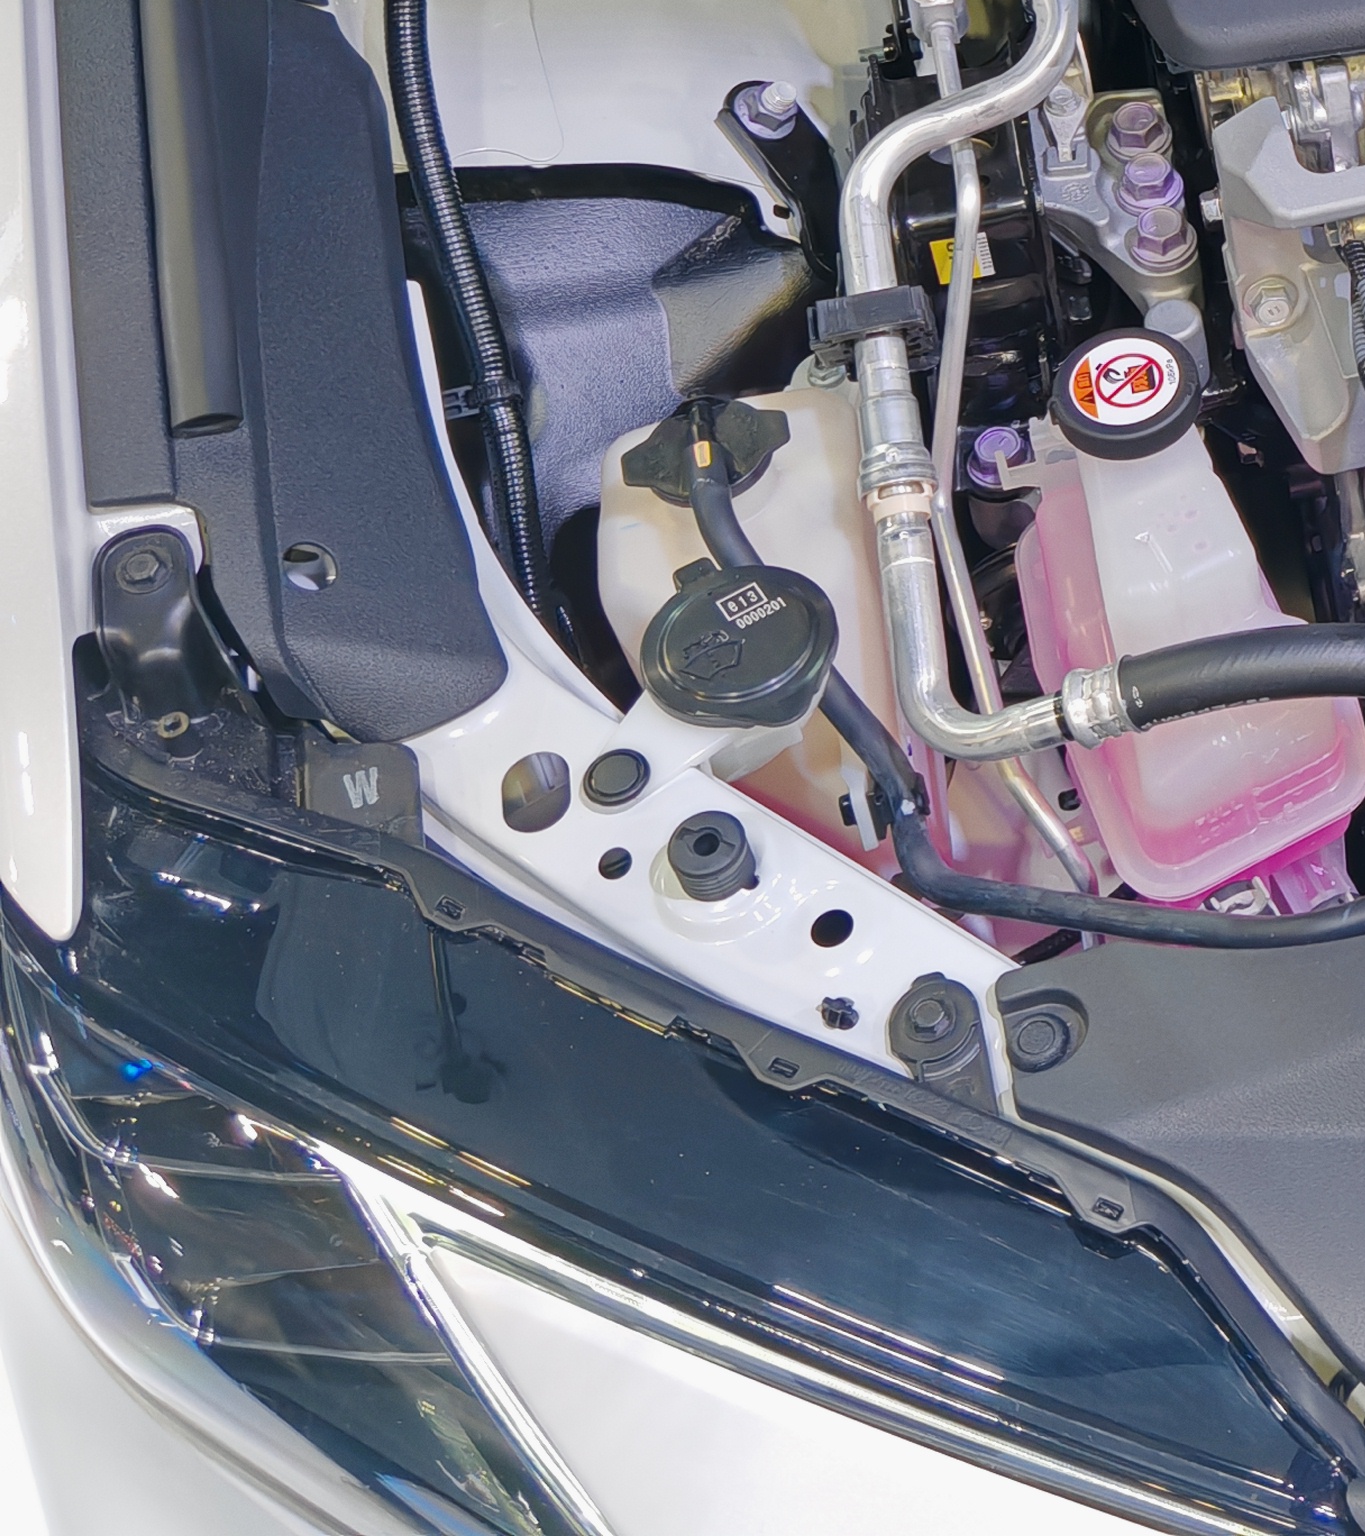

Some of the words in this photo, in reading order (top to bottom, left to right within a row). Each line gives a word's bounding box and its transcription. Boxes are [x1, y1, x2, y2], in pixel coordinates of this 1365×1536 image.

[727, 590, 758, 613] e13
[735, 596, 787, 629] 0000201
[343, 766, 380, 809] W
